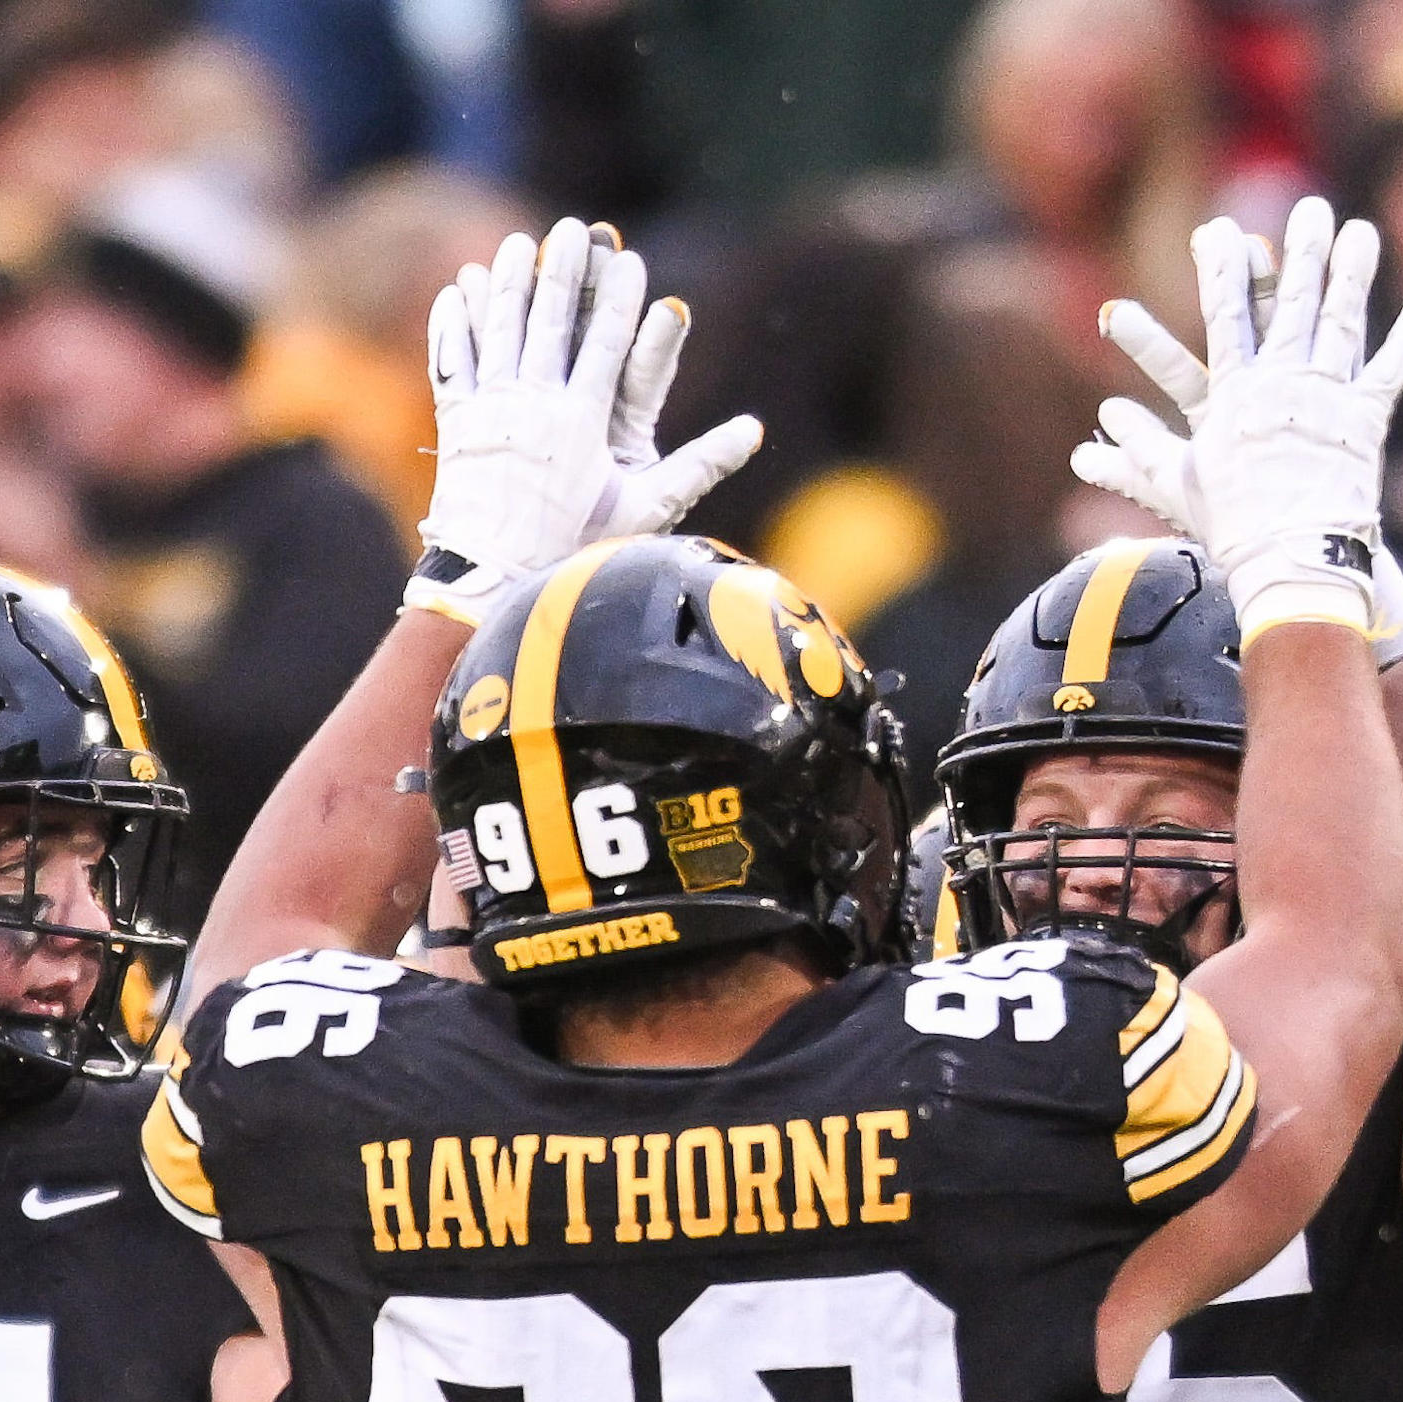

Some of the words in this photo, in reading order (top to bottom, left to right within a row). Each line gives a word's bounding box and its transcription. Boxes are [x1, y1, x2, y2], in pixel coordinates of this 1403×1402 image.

[472, 781, 651, 895] 96
[494, 911, 681, 972] TOGETHER
[360, 1108, 912, 1253] HAWTHORNE
